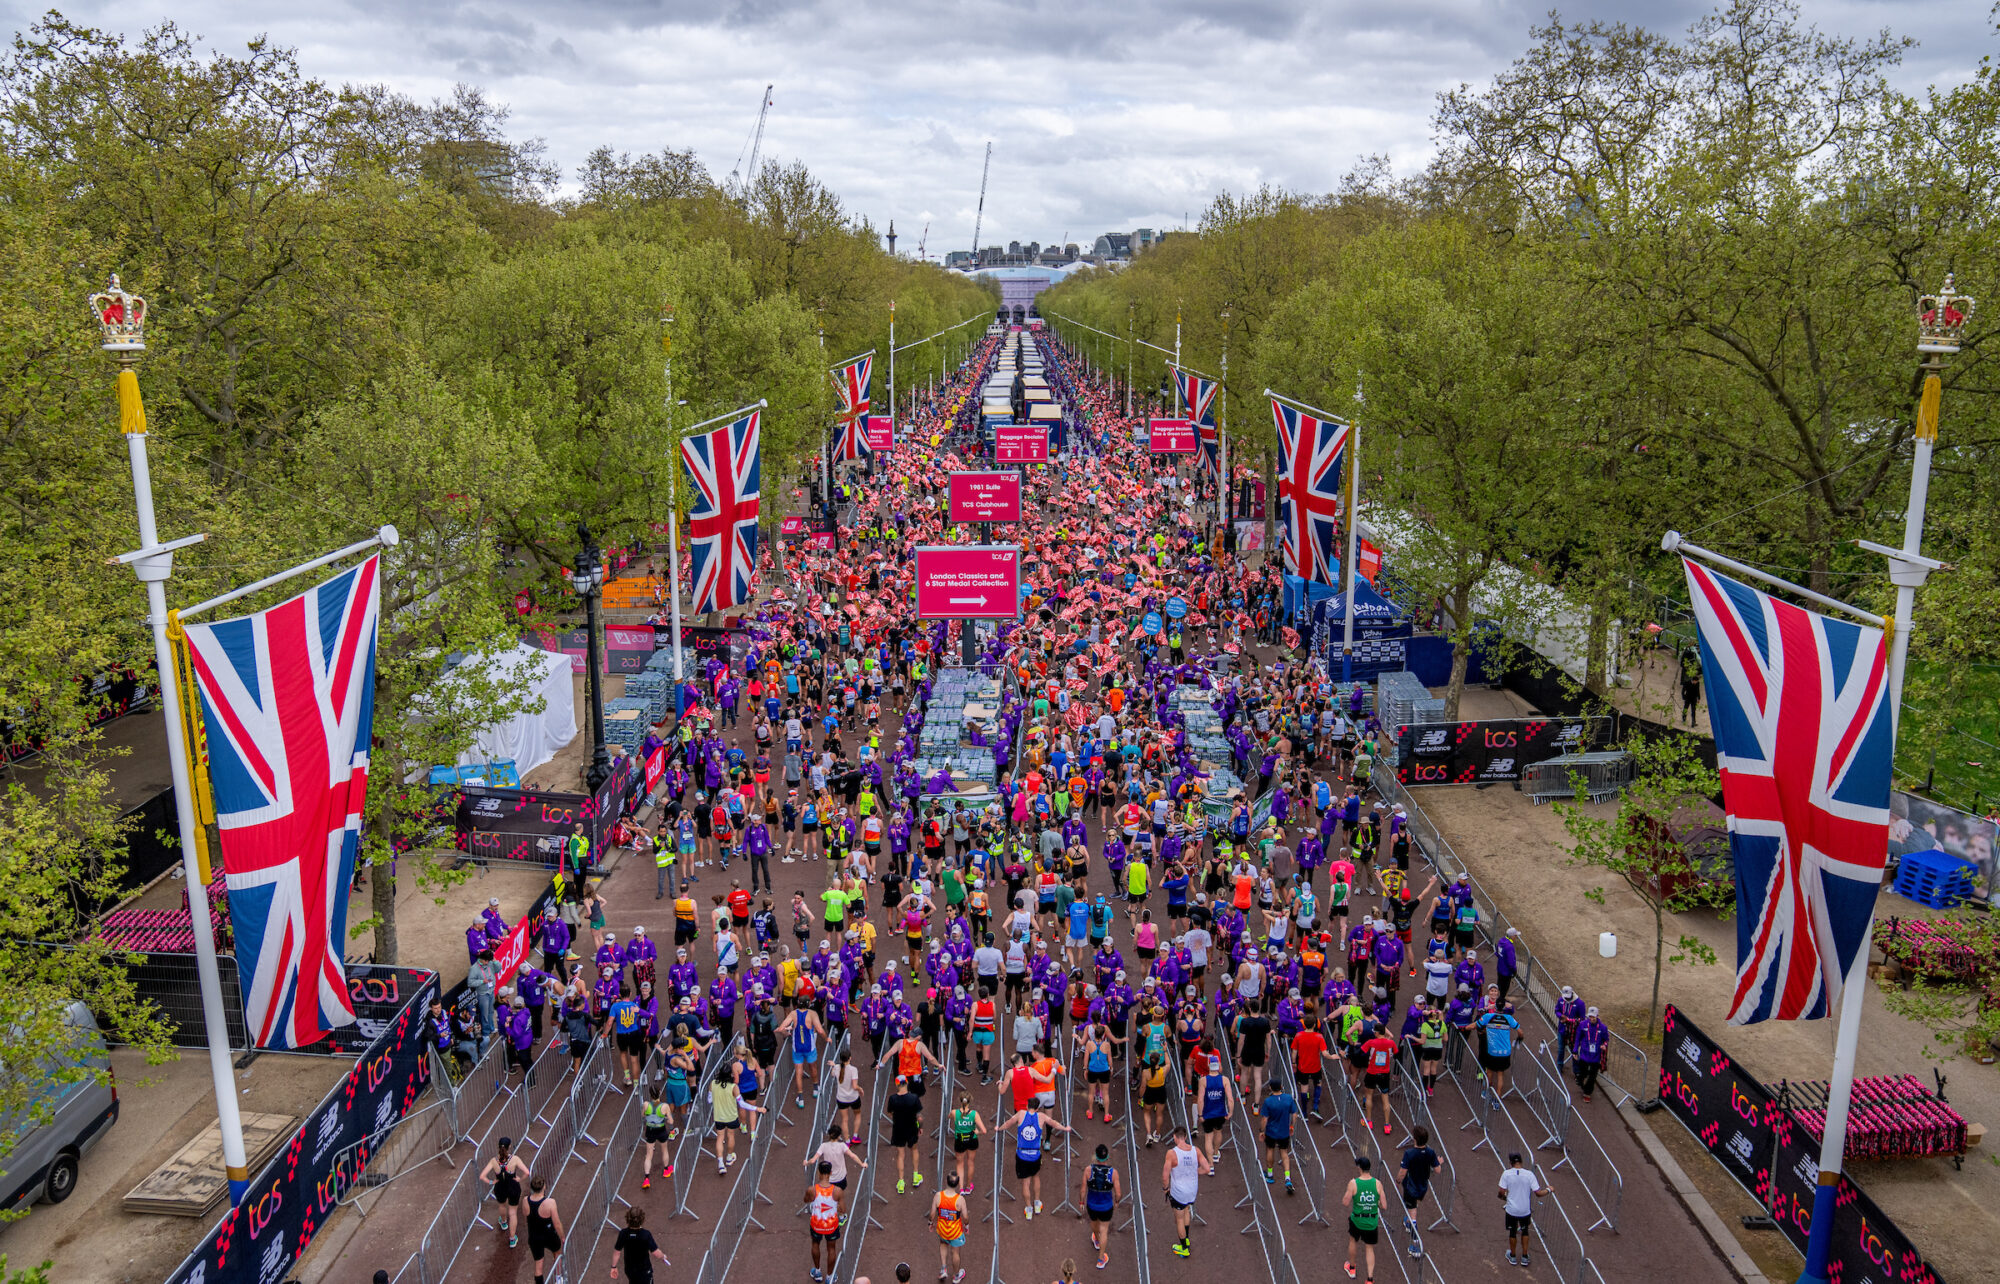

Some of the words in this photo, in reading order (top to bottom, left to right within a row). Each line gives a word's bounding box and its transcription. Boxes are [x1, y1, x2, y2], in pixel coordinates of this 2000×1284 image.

[696, 636, 717, 650] tcs
[1485, 728, 1517, 748] tcs
[1415, 763, 1447, 780] tcs
[482, 810, 504, 818] balance
[542, 803, 572, 824] tcs
[367, 1046, 392, 1093] tcs
[418, 1052, 430, 1083] tc
[1676, 1071, 1698, 1116] tcs
[1732, 1081, 1758, 1128] tcs
[312, 1150, 323, 1166] new
[323, 1123, 344, 1153] balance
[317, 1161, 346, 1214] tcs
[248, 1179, 282, 1240] tcs
[1792, 1192, 1811, 1236] tc
[1860, 1217, 1894, 1277] tcs
